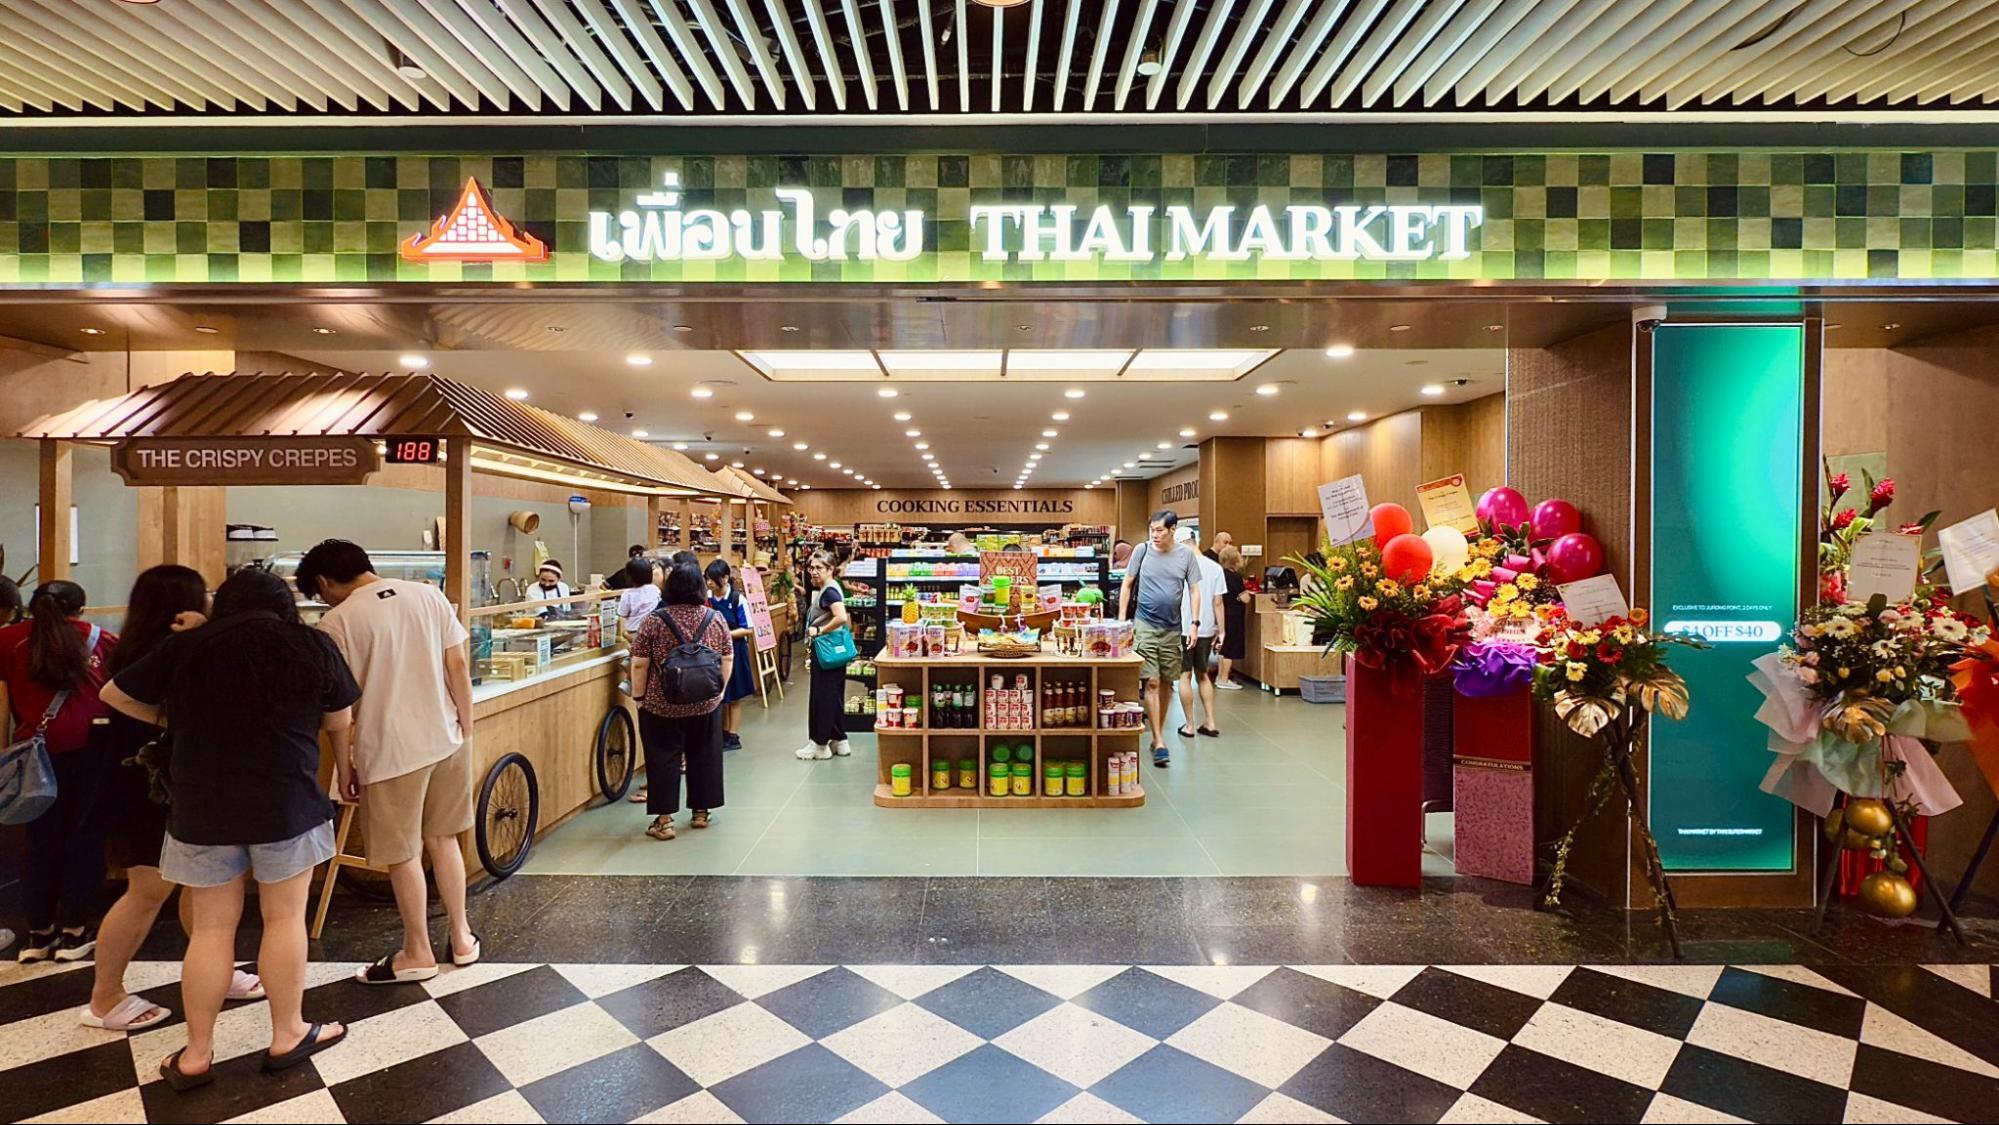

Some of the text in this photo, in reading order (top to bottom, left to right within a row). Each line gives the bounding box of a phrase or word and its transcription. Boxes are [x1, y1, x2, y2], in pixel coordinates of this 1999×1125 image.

[970, 204, 1484, 262] THAI MARKET
[137, 448, 357, 468] THE CRISPY CREPES
[397, 441, 430, 461] 188
[877, 500, 1073, 513] COOKING ESSENTIALS
[996, 566, 1019, 576] BEST
[1703, 625, 1734, 637] OFF
